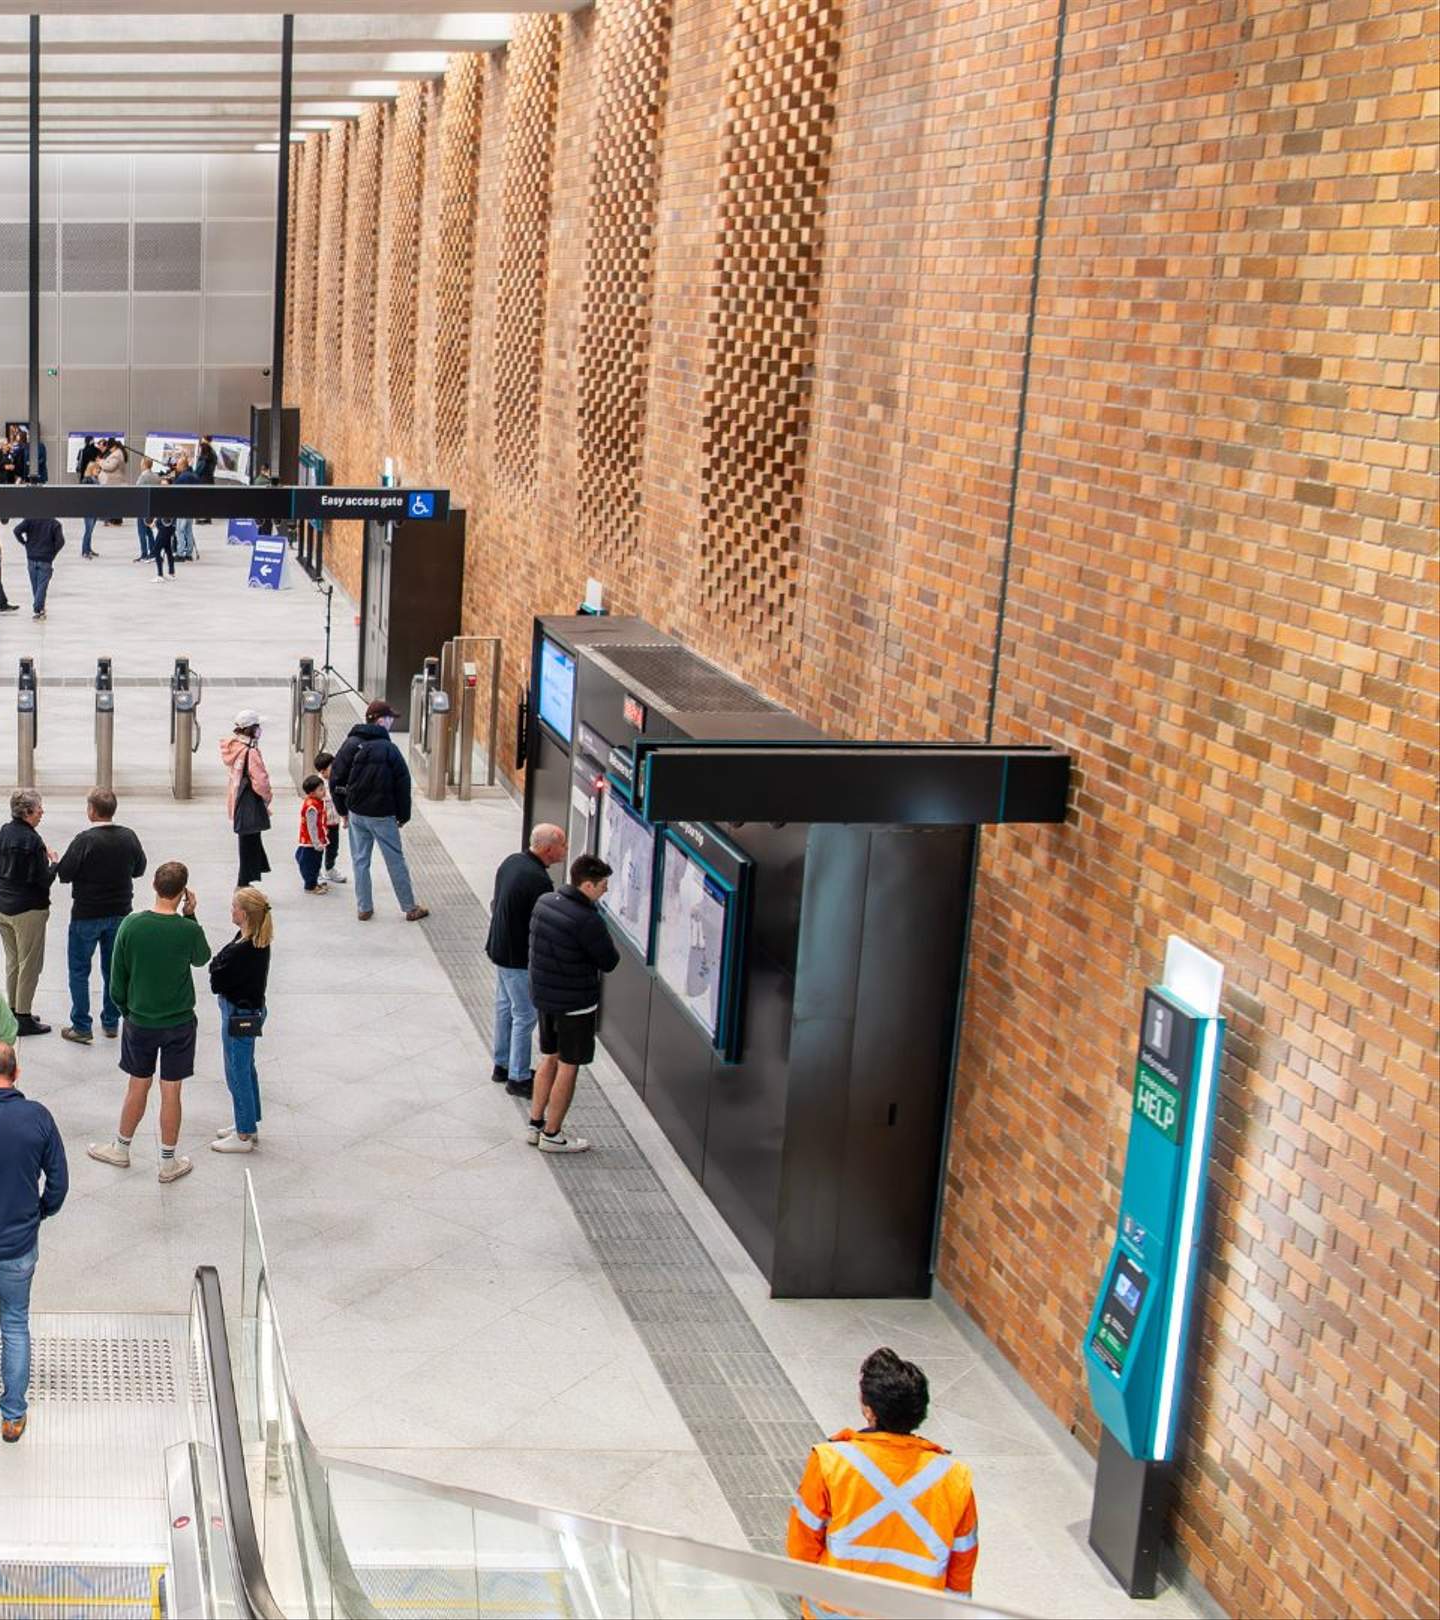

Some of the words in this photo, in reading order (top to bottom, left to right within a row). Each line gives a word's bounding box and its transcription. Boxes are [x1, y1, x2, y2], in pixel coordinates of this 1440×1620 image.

[321, 495, 345, 508] Easy
[345, 496, 380, 507] access
[380, 496, 404, 508] gate
[1136, 1085, 1175, 1130] HELP
